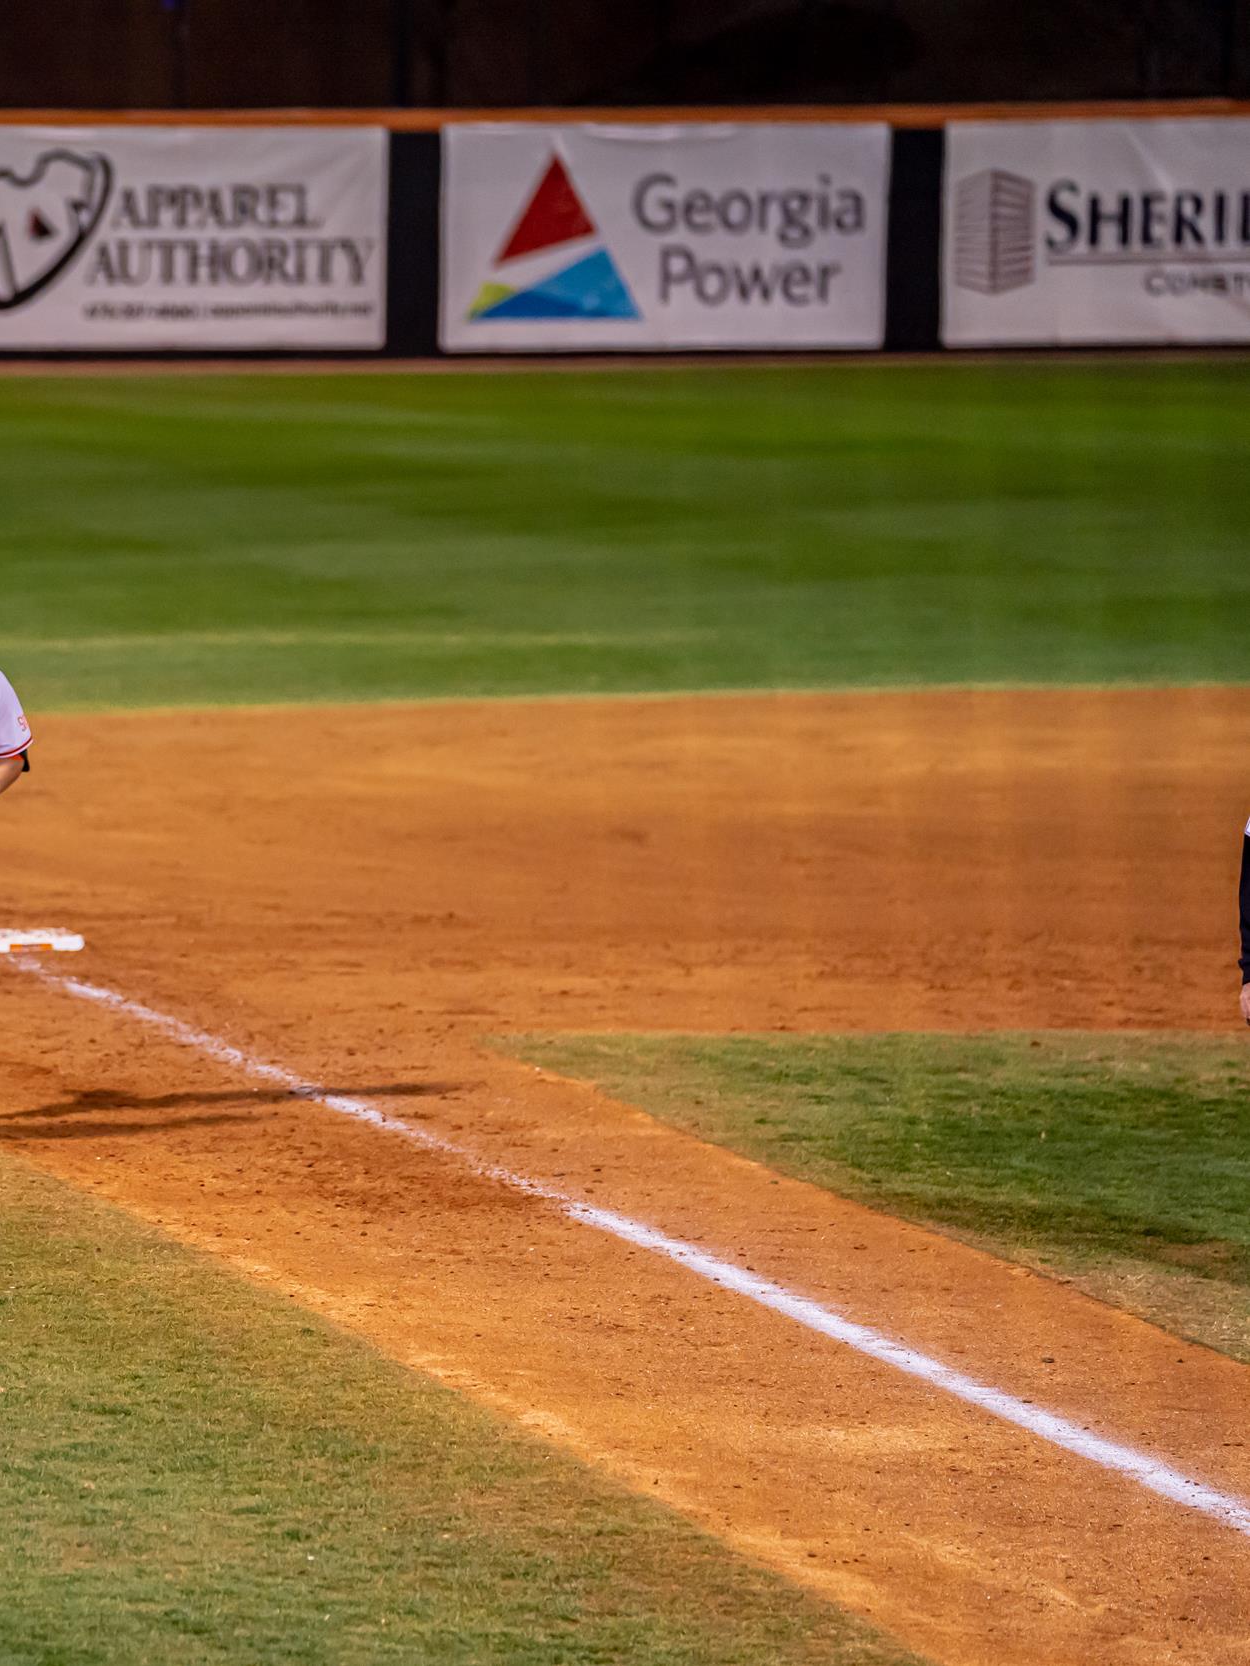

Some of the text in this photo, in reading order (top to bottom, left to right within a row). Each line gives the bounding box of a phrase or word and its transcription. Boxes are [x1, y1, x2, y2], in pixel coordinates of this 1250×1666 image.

[110, 182, 326, 230] APPAREL
[631, 172, 868, 249] Georgia
[85, 237, 376, 288] AUTHORITY
[658, 244, 842, 307] Power
